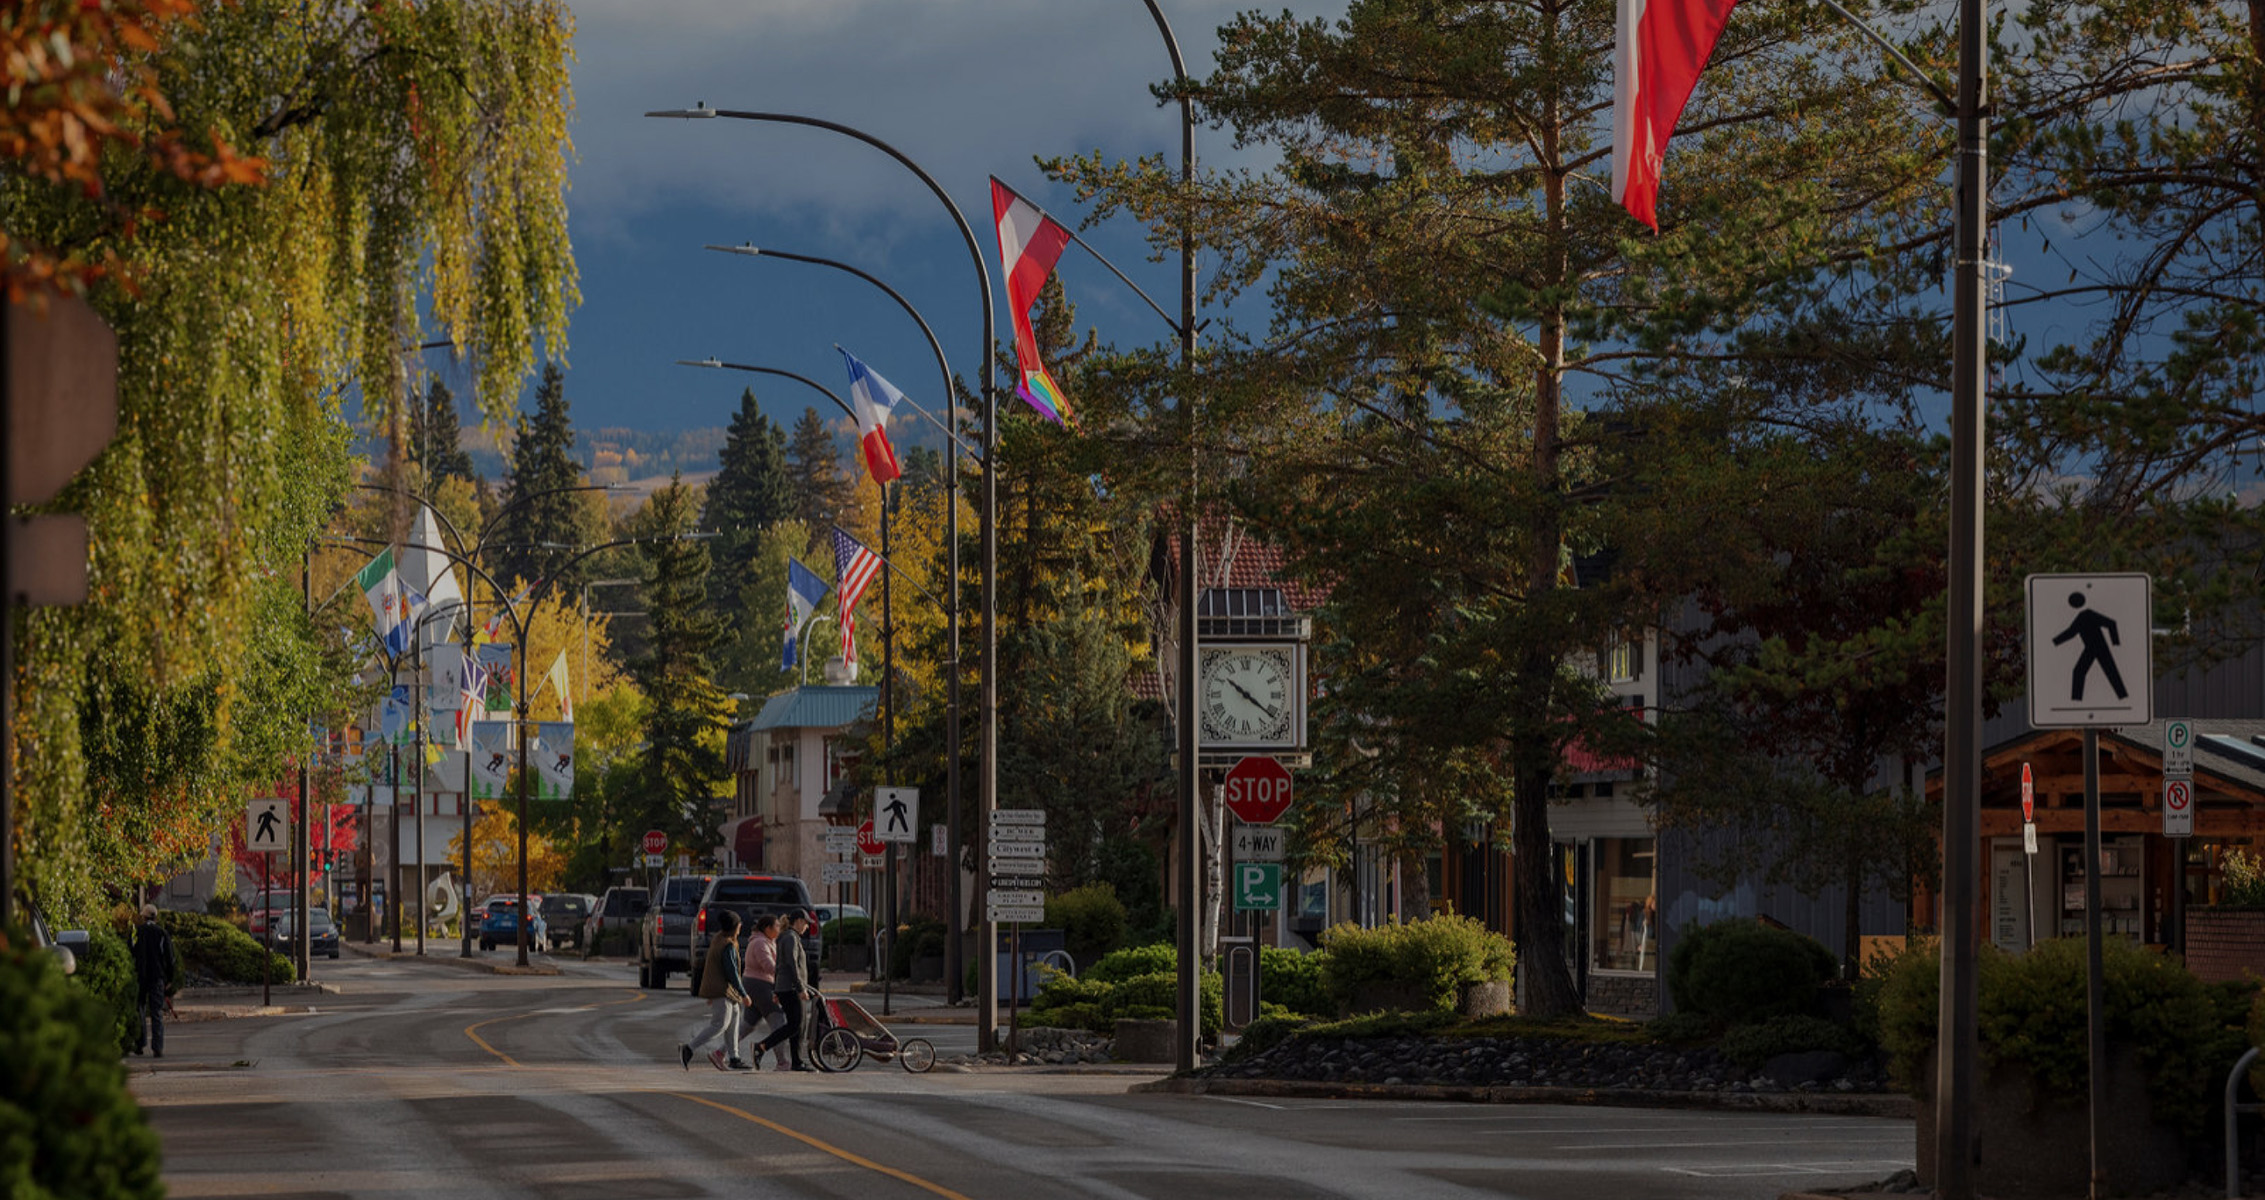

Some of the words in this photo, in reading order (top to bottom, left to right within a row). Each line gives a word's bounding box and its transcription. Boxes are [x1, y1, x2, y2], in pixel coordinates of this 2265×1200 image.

[1228, 777, 1289, 802] STOP
[643, 837, 666, 848] STOP
[1238, 836, 1277, 851] 4-WAY
[1243, 867, 1265, 894] P
